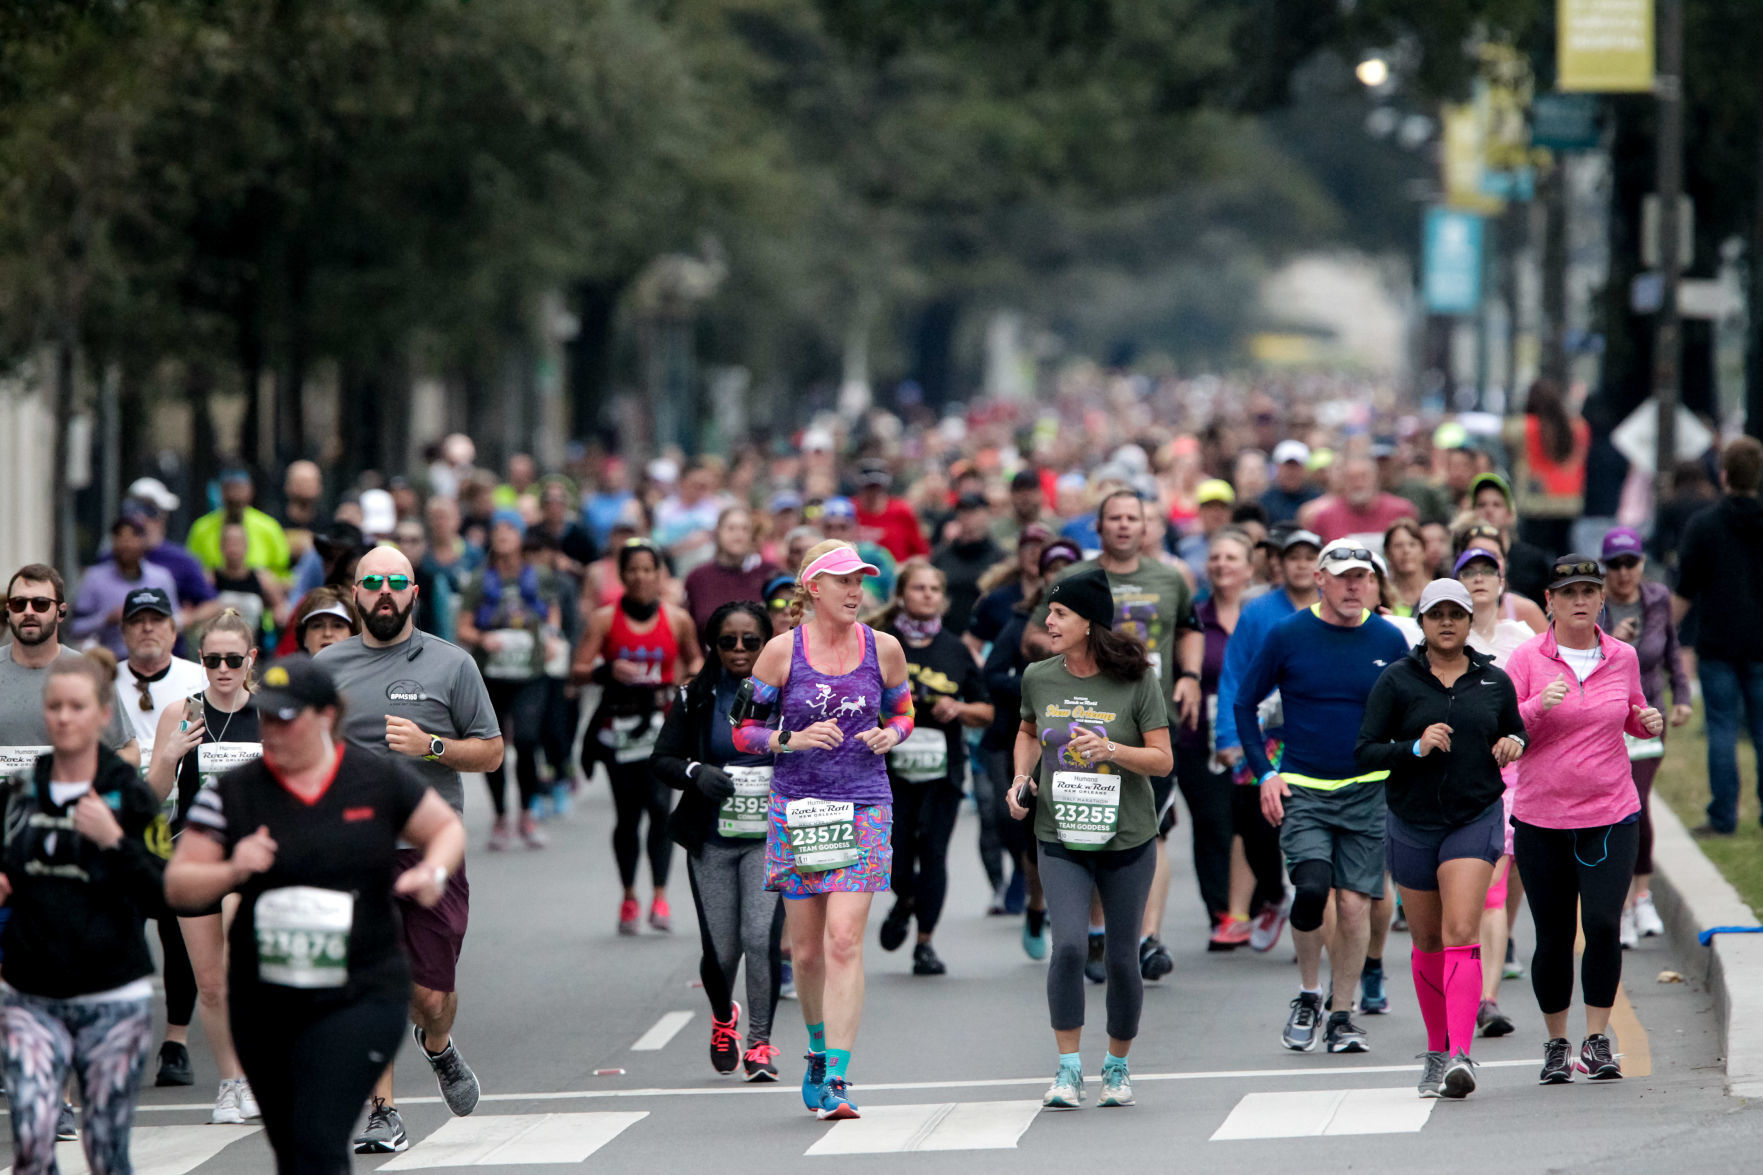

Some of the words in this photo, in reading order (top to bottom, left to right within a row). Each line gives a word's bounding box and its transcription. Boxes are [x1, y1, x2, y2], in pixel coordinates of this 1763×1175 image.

[202, 751, 229, 759] Rock
[1073, 775, 1099, 783] Humana
[1057, 780, 1084, 790] Rock
[1093, 782, 1116, 792] Roll
[791, 806, 817, 815] Rock
[827, 804, 849, 812] Roll
[1055, 803, 1116, 824] 23255
[1076, 823, 1111, 831] GODDESS
[792, 823, 854, 846] 23572
[799, 845, 818, 853] TEAM
[818, 841, 851, 851] GODDESS
